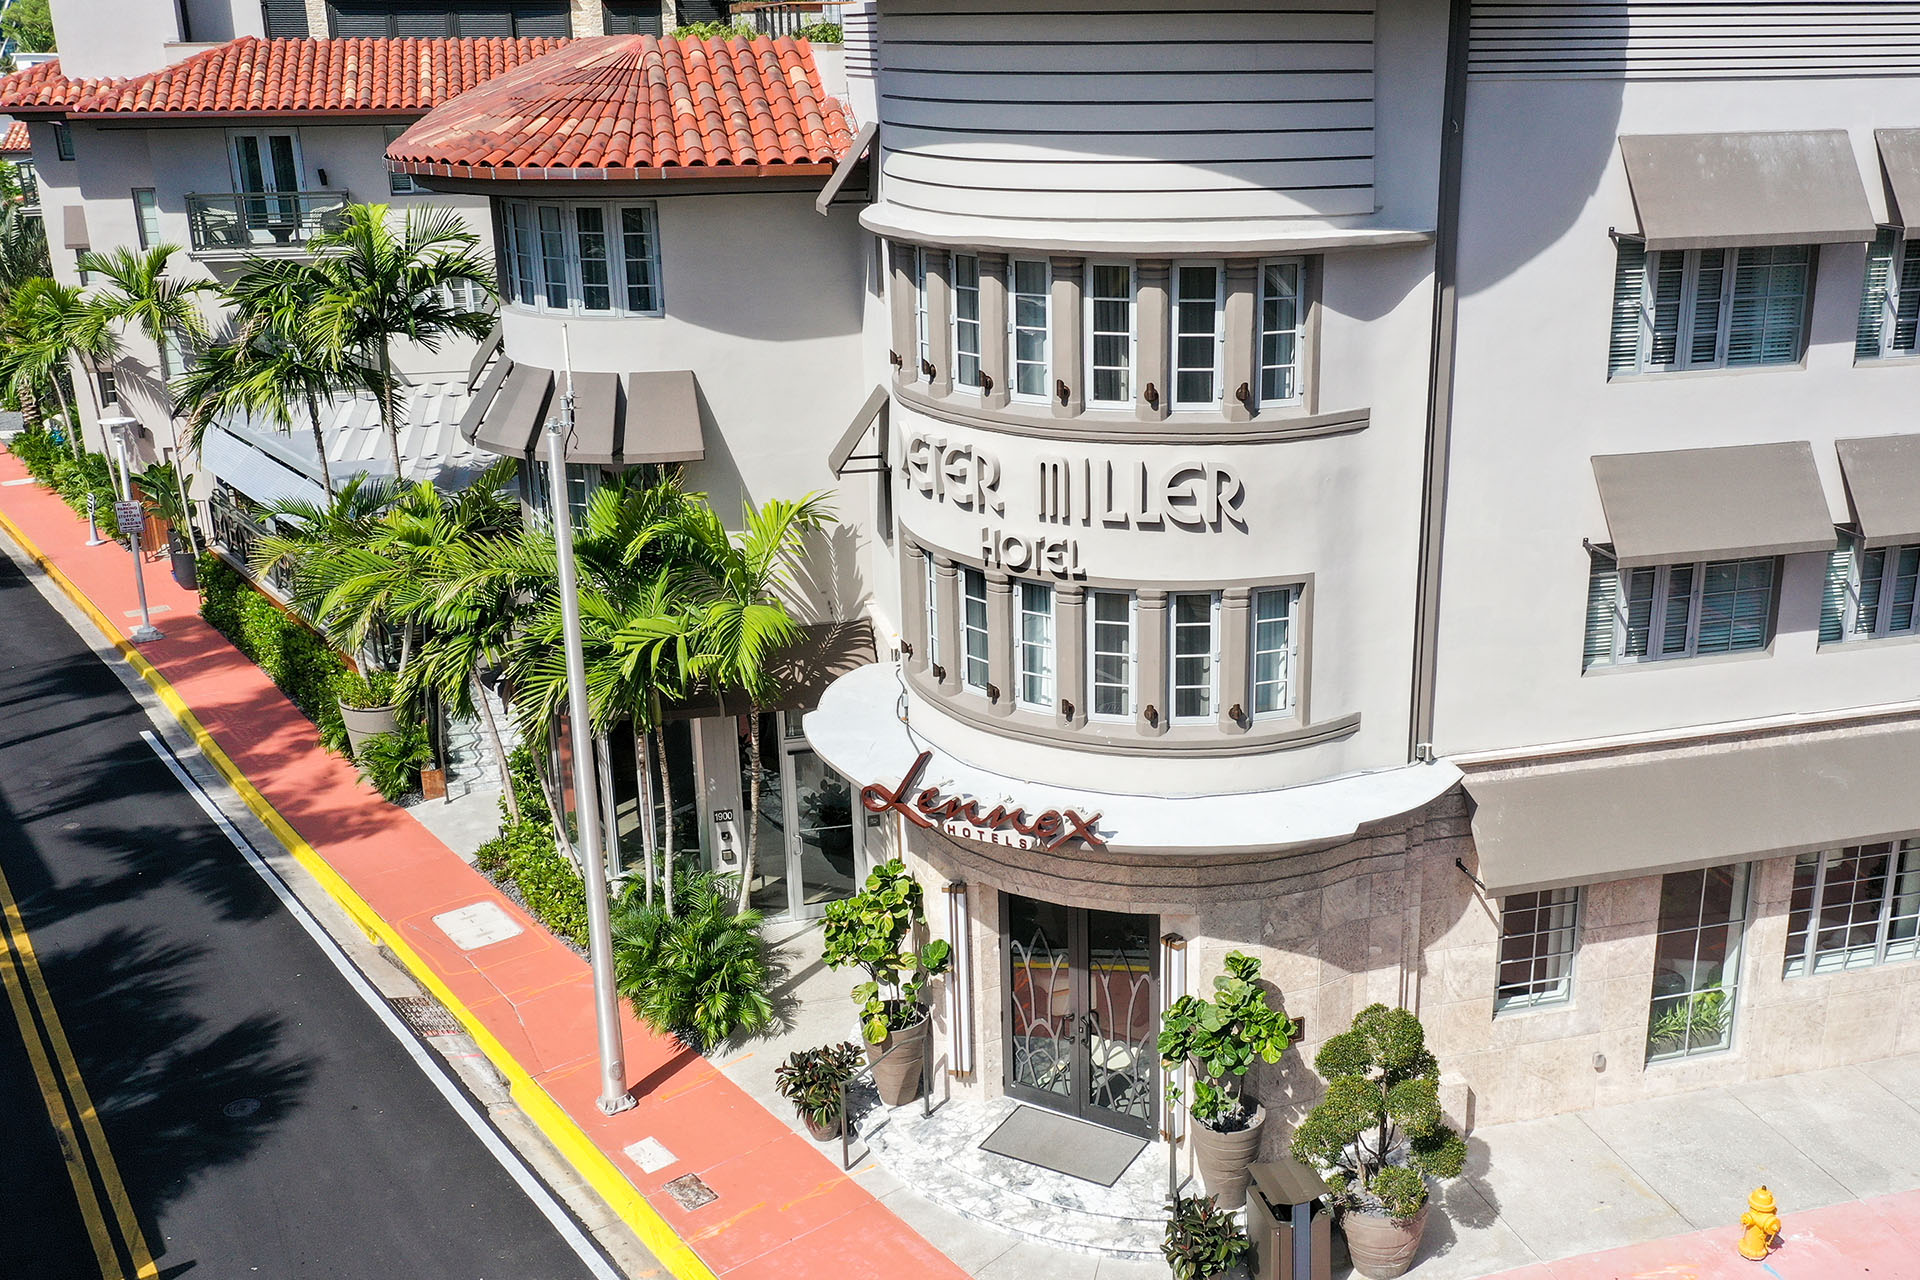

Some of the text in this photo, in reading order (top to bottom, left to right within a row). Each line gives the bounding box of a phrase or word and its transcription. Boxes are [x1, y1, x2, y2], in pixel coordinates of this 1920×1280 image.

[1035, 456, 1248, 532] MILLER
[979, 526, 1087, 579] HOTEL
[714, 812, 732, 821] 1900
[861, 750, 1108, 851] Lennox
[946, 825, 1028, 849] HOTELS
